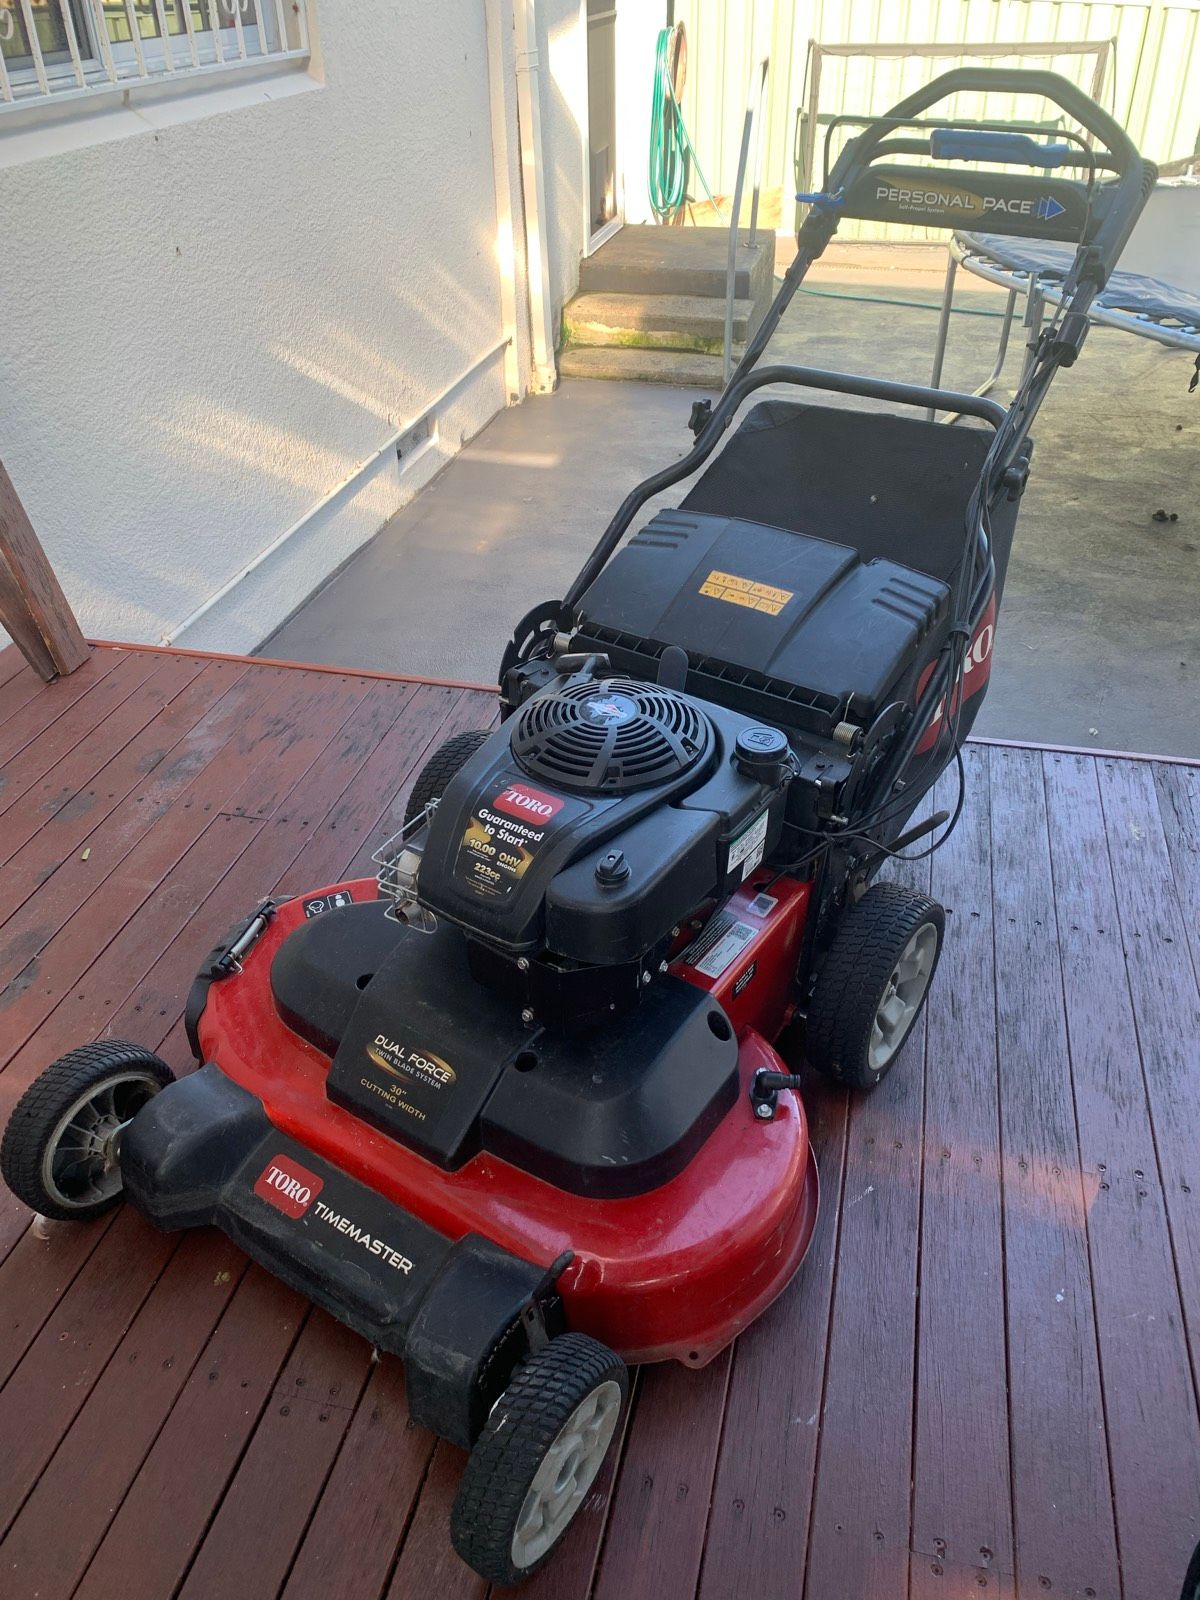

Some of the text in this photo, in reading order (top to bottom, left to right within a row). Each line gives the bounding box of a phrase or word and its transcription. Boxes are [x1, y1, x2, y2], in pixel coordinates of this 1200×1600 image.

[876, 187, 1031, 214] PERSONAL PACE
[505, 790, 553, 815] TORO
[478, 808, 545, 842] Guaranteed
[484, 824, 495, 835] to
[469, 838, 496, 856] 10.00
[498, 852, 521, 867] OHV
[474, 862, 501, 881] 223cc
[374, 1034, 452, 1083] DUAL FORCE
[375, 1047, 442, 1090] TWIN BLADE SYSTEM
[360, 1078, 426, 1121] CUTTING WIDTH
[265, 1166, 311, 1204] TORO
[313, 1201, 414, 1275] TIMEMASTER
